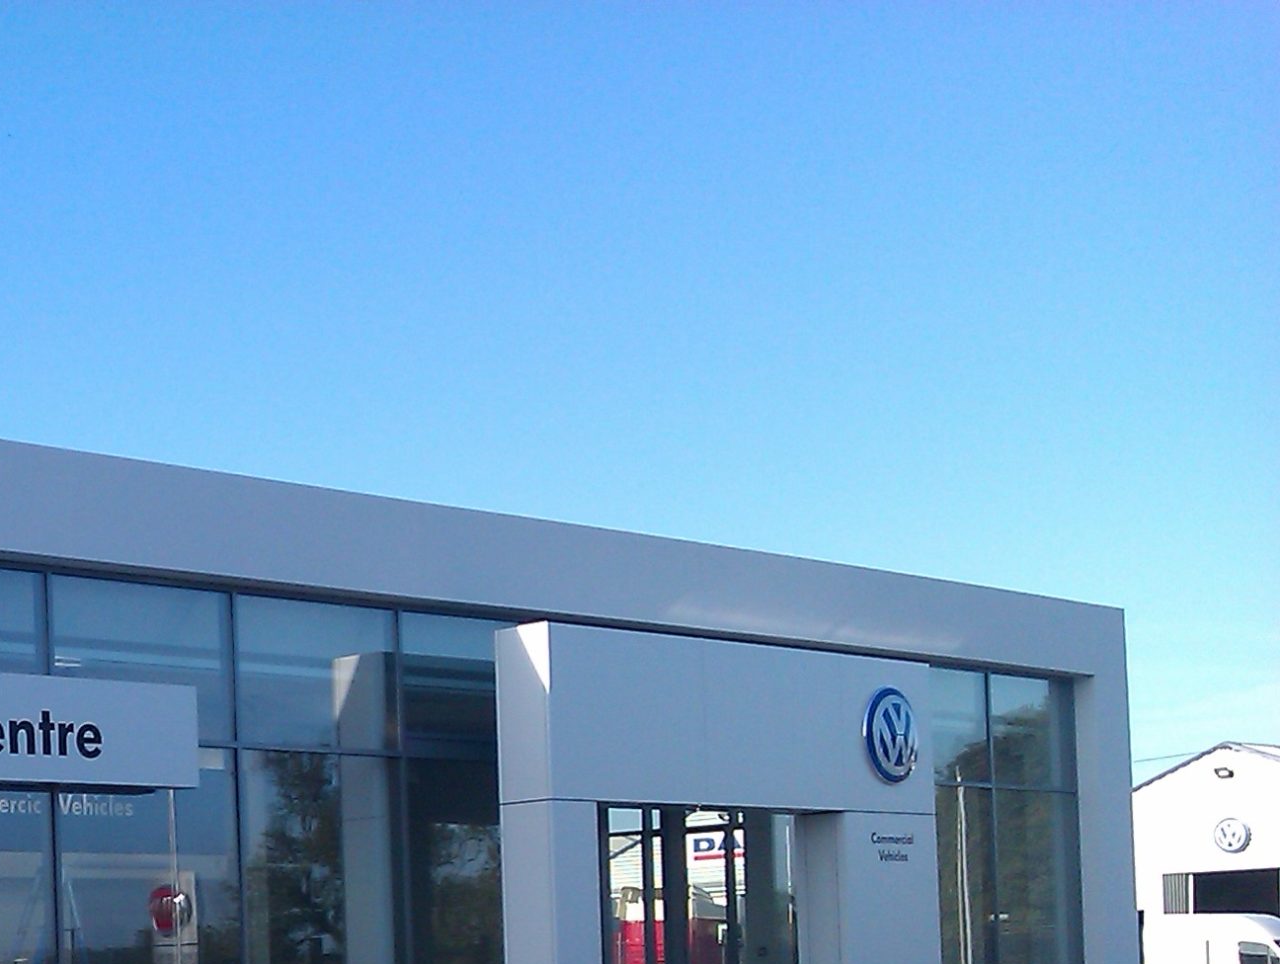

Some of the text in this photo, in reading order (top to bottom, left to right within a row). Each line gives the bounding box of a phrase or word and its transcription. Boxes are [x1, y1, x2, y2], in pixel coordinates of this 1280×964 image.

[58, 793, 134, 816] Vehicles
[870, 831, 914, 845] Commercial
[878, 849, 909, 862] Vehicles
